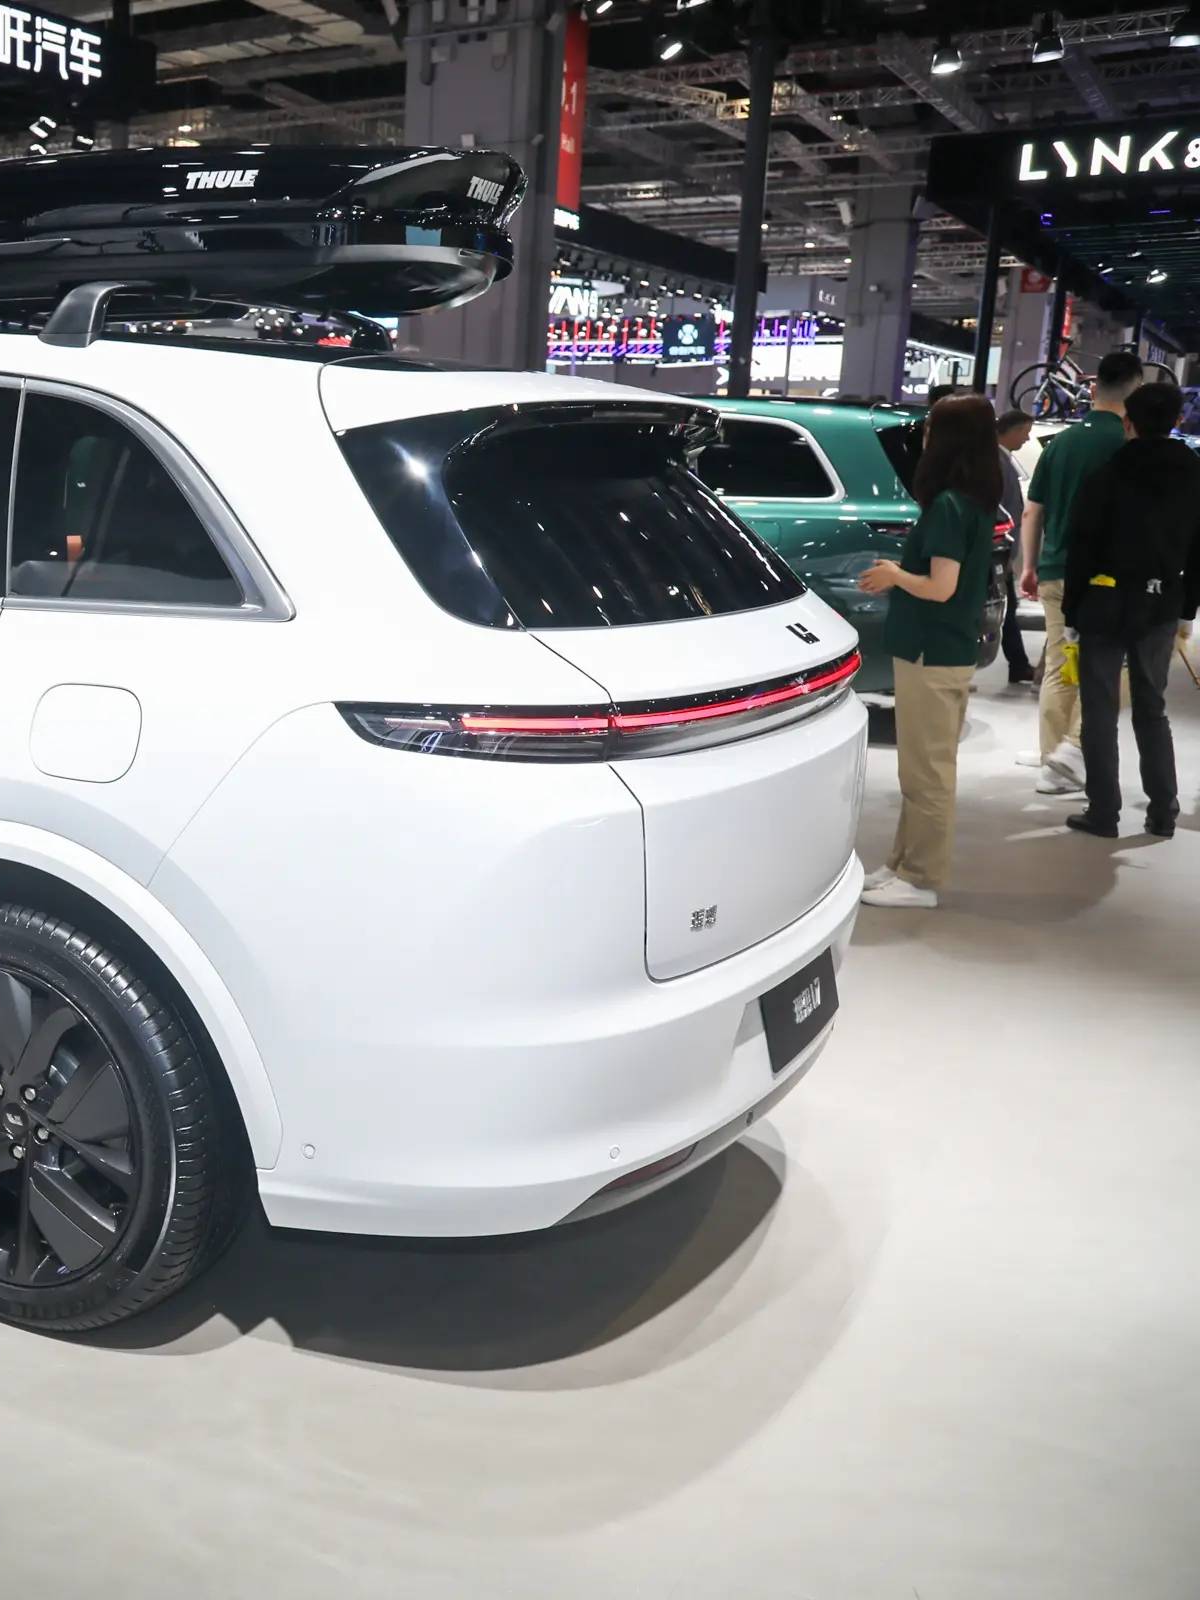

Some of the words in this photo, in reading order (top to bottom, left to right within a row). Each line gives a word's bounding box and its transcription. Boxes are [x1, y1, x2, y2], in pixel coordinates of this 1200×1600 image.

[1018, 131, 1179, 182] LYNK
[186, 169, 259, 190] THULE
[466, 175, 505, 206] THULE
